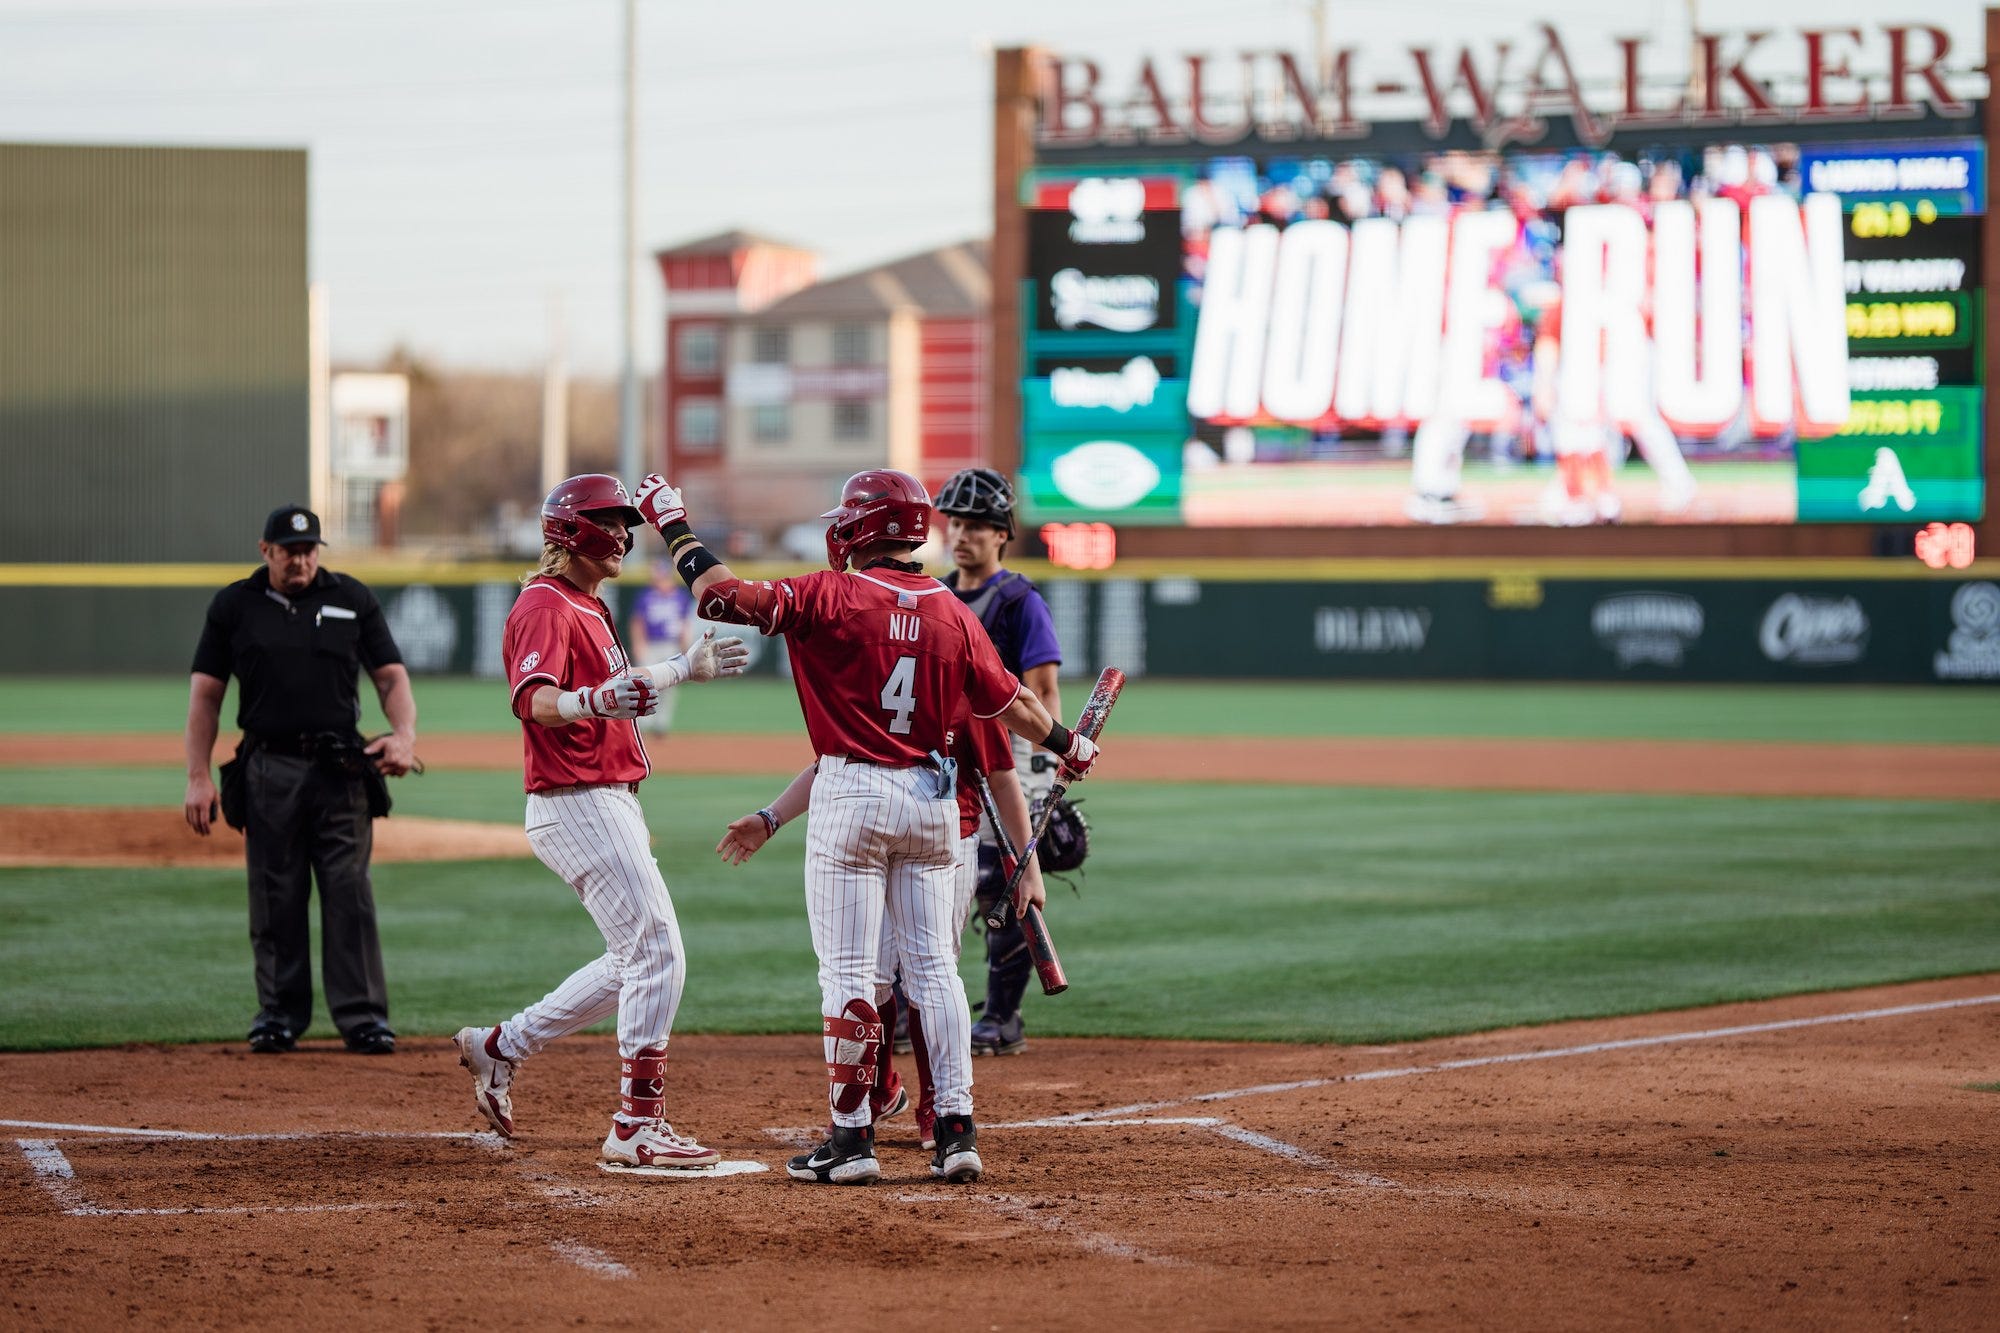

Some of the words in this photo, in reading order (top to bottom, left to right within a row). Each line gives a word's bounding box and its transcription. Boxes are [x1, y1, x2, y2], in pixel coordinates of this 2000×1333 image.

[1038, 21, 1976, 149] BAUM-WALKER
[1187, 209, 1518, 422] HOME
[1559, 193, 1850, 426] RUN
[521, 652, 539, 672] SEC
[889, 613, 920, 642] NIU
[880, 655, 917, 735] 4
